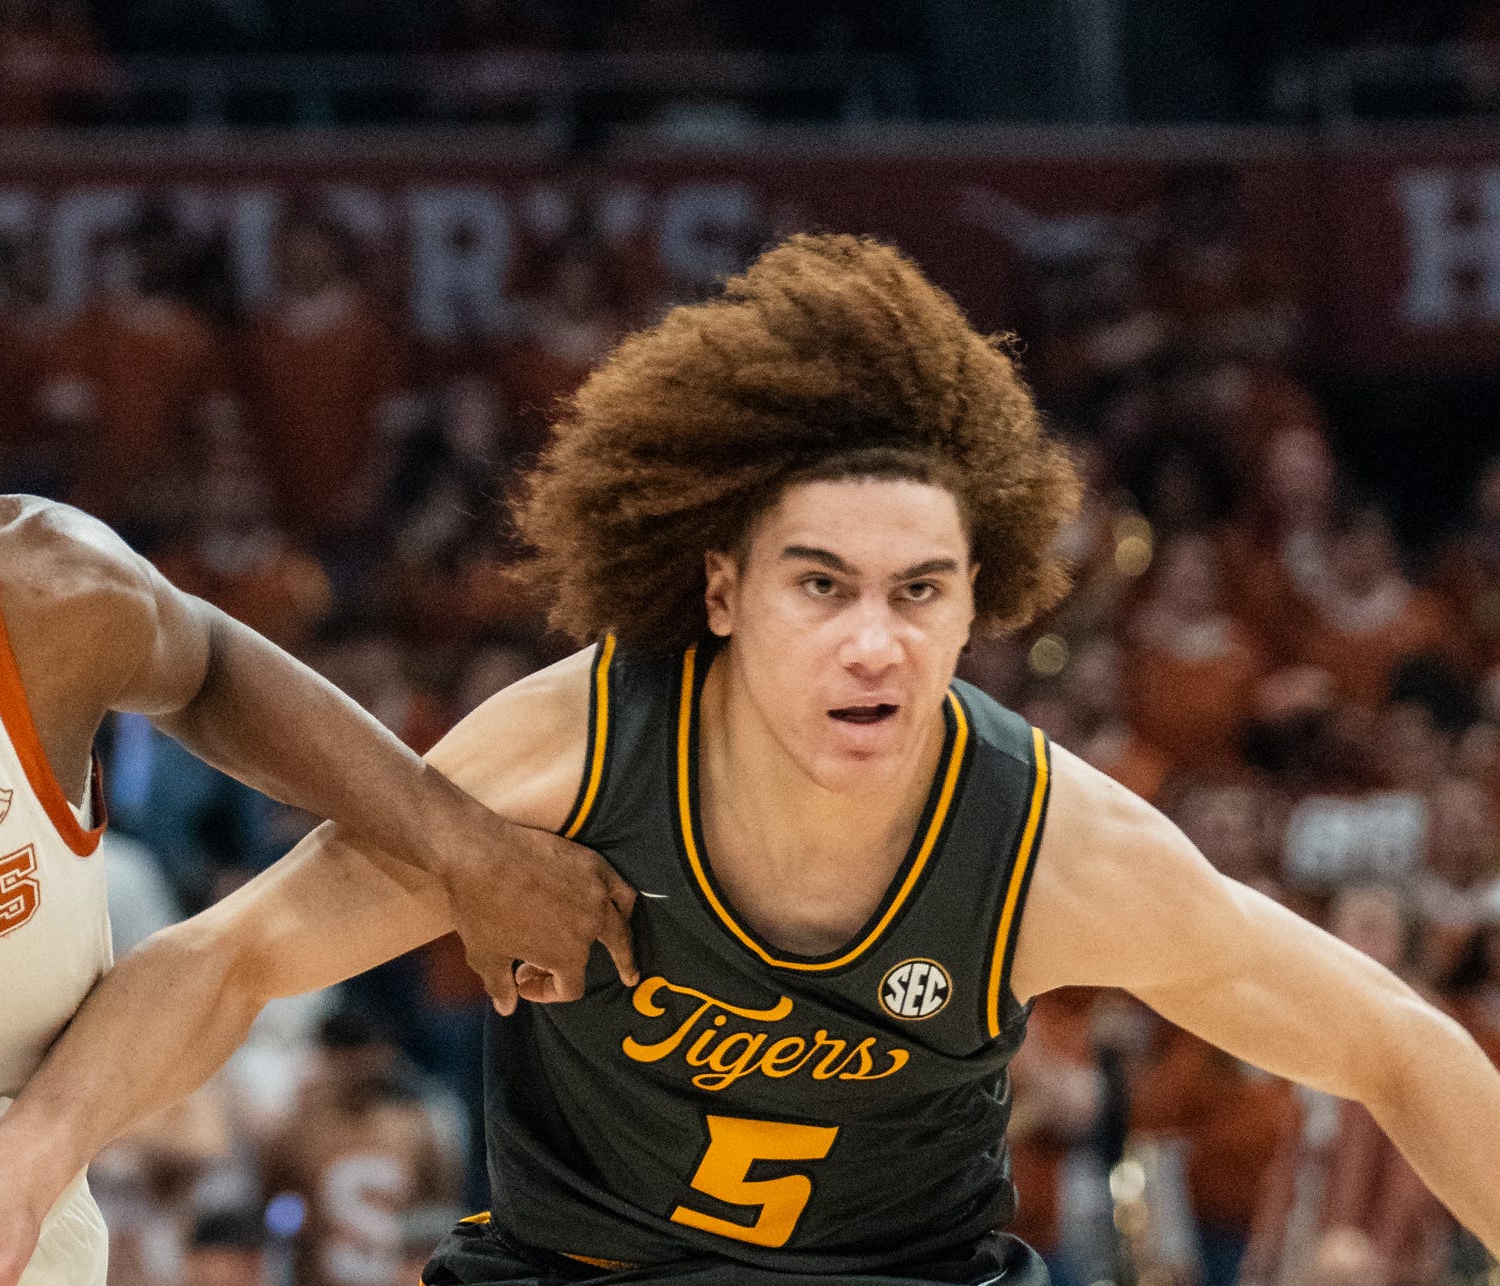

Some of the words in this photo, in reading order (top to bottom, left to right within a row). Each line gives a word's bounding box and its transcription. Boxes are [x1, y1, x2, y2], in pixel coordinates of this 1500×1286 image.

[622, 976, 910, 1091] Tigers
[884, 961, 948, 1017] SEC
[669, 1114, 840, 1249] 5
